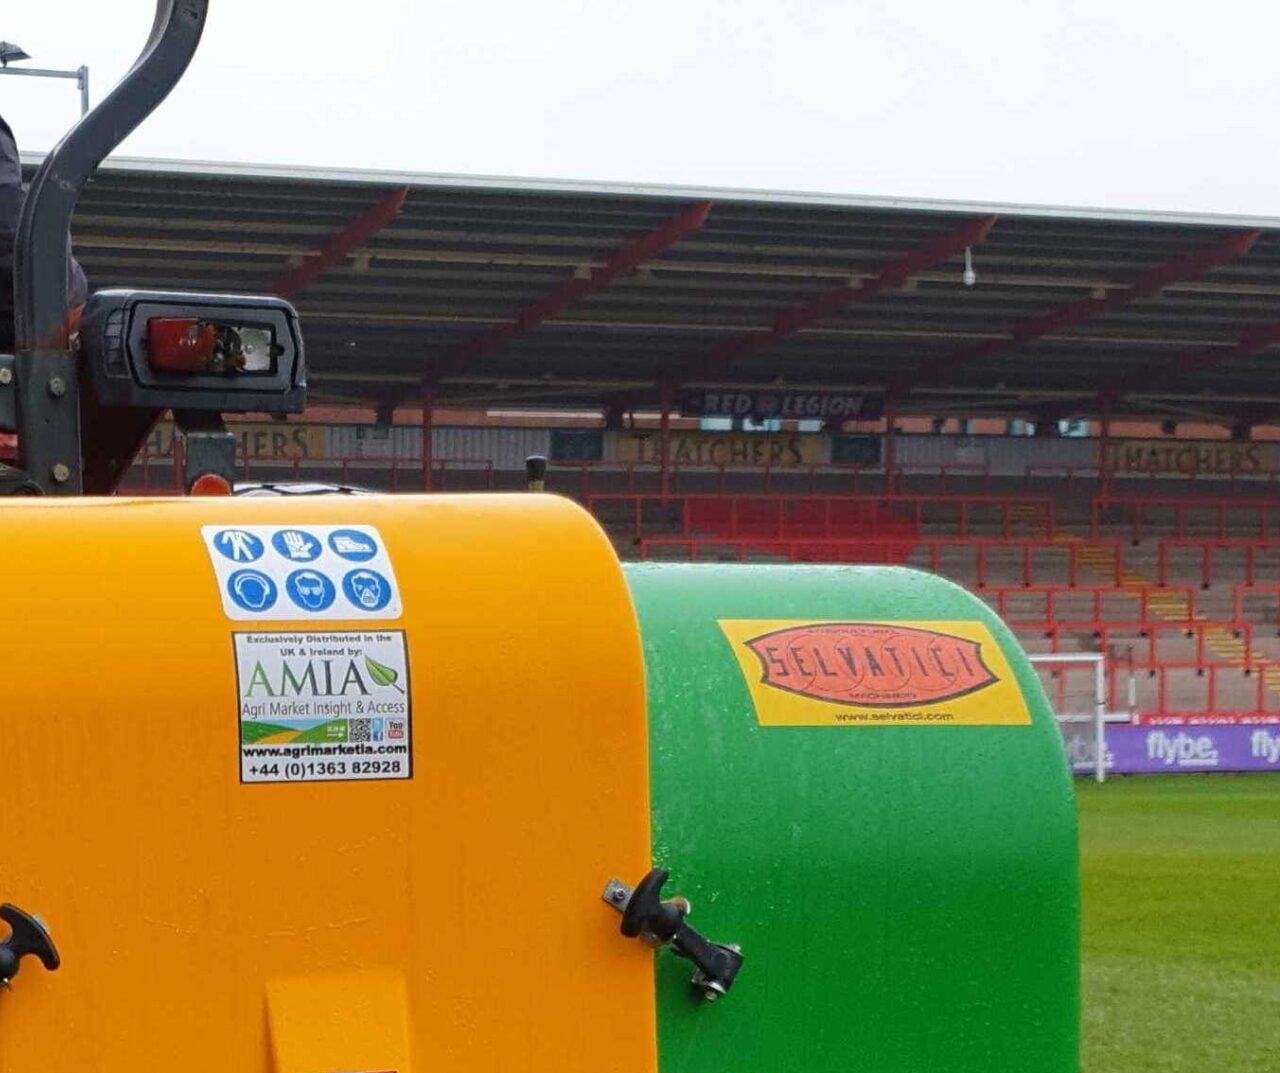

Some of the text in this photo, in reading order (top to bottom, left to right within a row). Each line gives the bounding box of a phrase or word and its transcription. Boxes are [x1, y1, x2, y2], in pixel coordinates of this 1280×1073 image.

[246, 634, 392, 645] Exclusively Distributed in the
[280, 648, 362, 658] UK & Ireland by:
[766, 646, 975, 677] SELVATICI
[245, 659, 372, 696] AMIA
[242, 700, 405, 719] Agri Market Insight & Access
[835, 712, 954, 722] www.selvatici.com
[243, 743, 407, 758] www.agrimarketia.com
[249, 760, 401, 778] +44 (0)1363 82928
